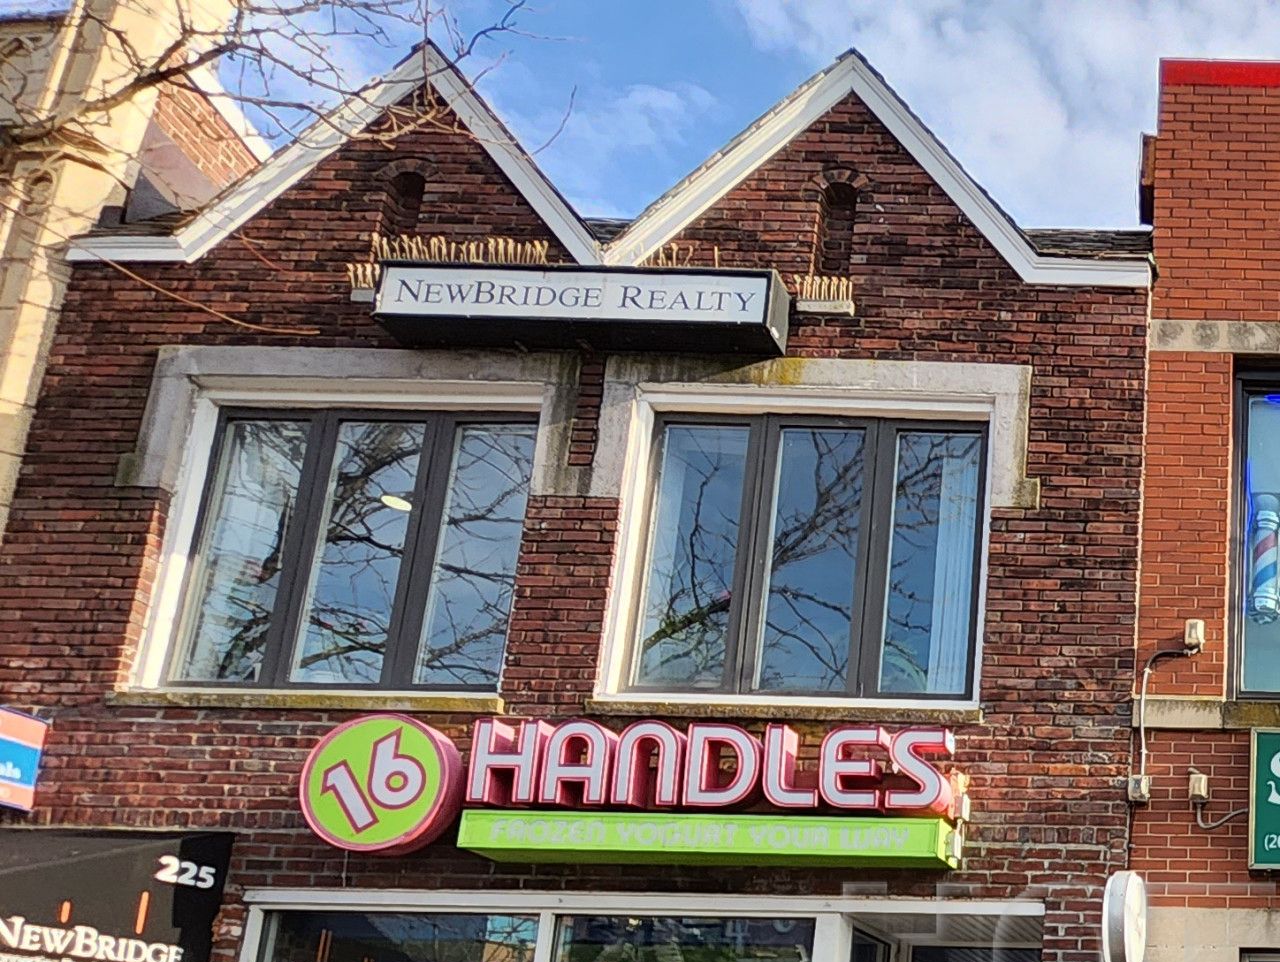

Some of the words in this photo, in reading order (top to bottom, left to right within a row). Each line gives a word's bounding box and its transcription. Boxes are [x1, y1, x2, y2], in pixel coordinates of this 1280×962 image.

[397, 277, 601, 309] NEWBRIDGE
[618, 285, 756, 313] REALTY
[321, 727, 428, 835] 16
[465, 717, 958, 811] HANDLES
[490, 819, 605, 844] FROZEN
[616, 822, 738, 848] YOGURT
[748, 824, 830, 849] YOUR
[840, 826, 910, 850] WAY
[155, 855, 216, 889] 225
